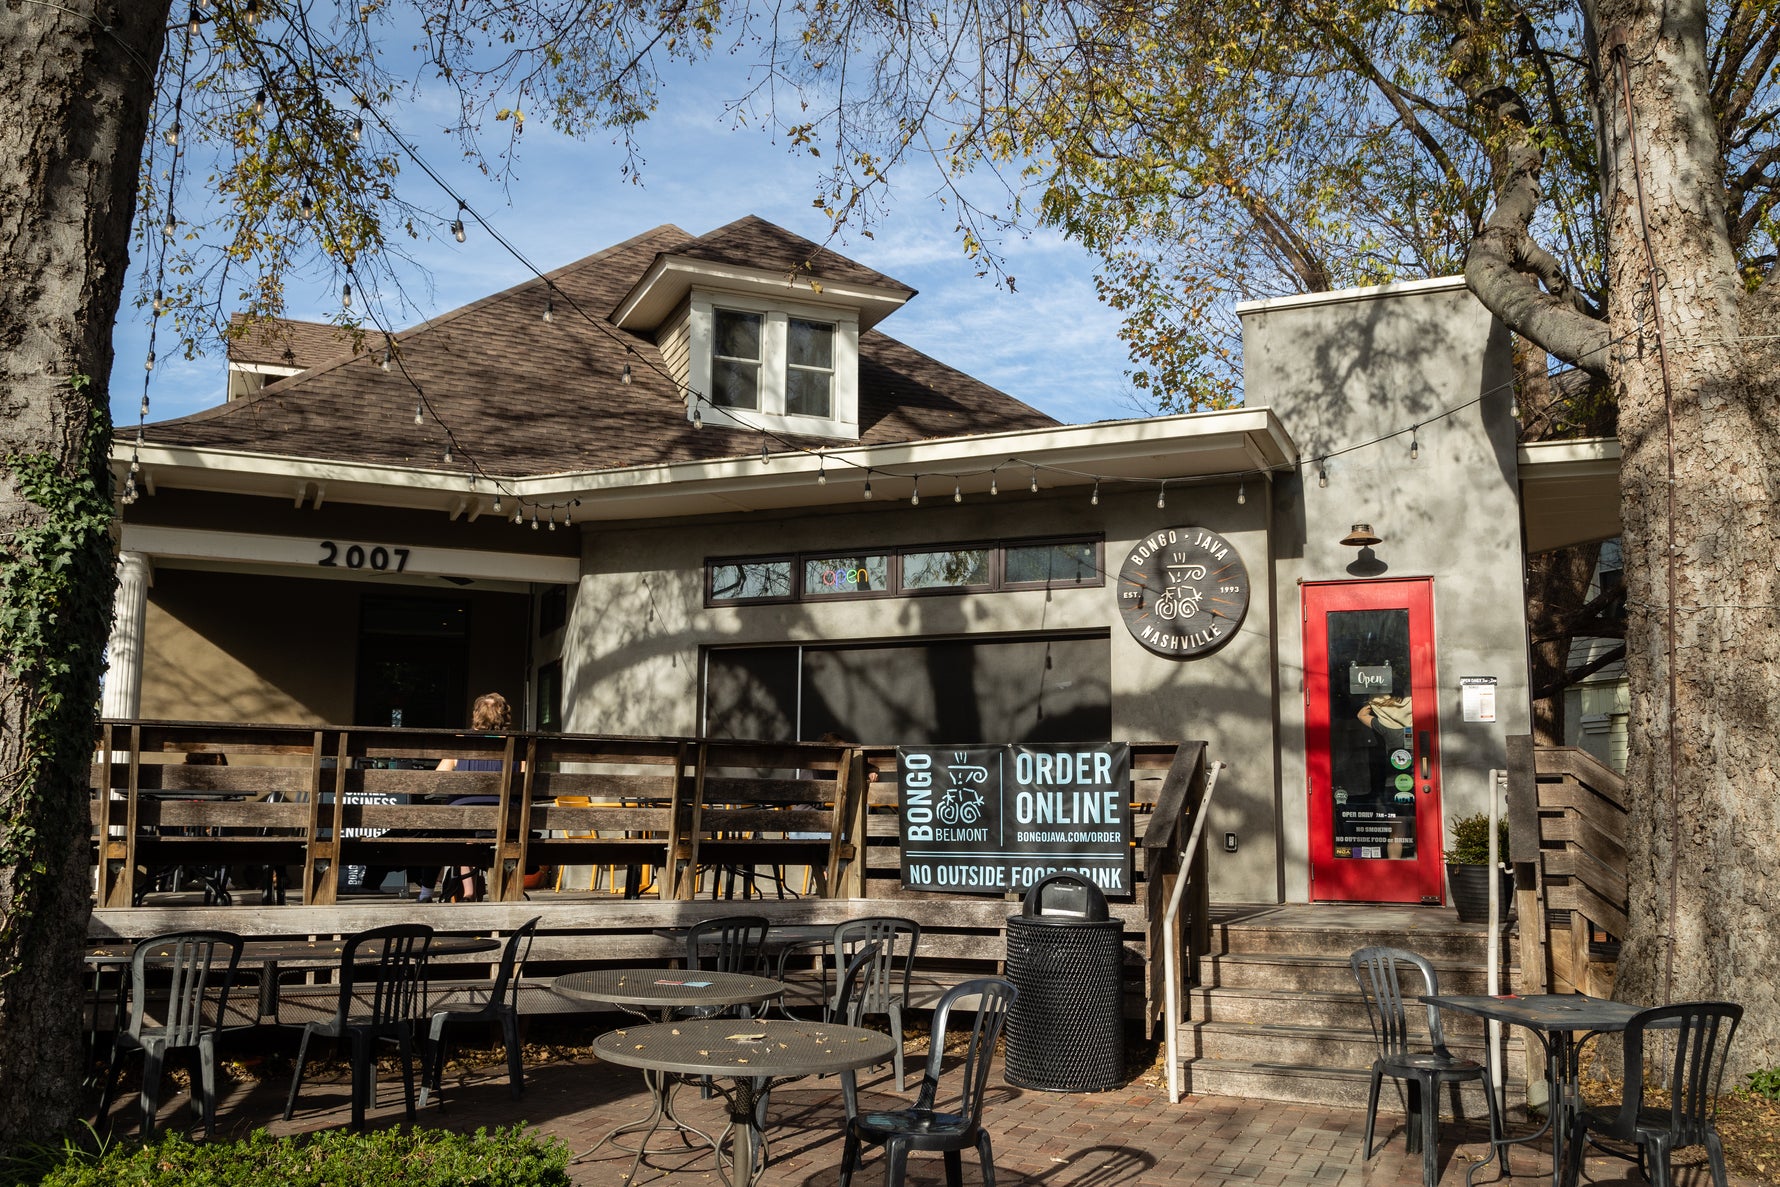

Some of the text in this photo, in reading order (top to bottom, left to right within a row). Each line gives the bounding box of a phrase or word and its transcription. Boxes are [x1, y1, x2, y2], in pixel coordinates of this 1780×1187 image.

[319, 541, 410, 573] 2007
[1131, 530, 1229, 566] BONGO JAVA
[822, 568, 869, 588] open
[1123, 591, 1141, 599] EST.
[1140, 623, 1222, 650] NASHVILLE
[1358, 671, 1385, 688] Open
[1016, 752, 1112, 785] ORDER
[905, 753, 934, 842] BONGO
[1016, 791, 1121, 824] ONLINE
[935, 828, 988, 842] BELMONT
[1017, 831, 1121, 843] BONGOJAVA.COM/ORDER
[910, 864, 931, 885] NO
[937, 865, 1005, 887] OUTSIDE
